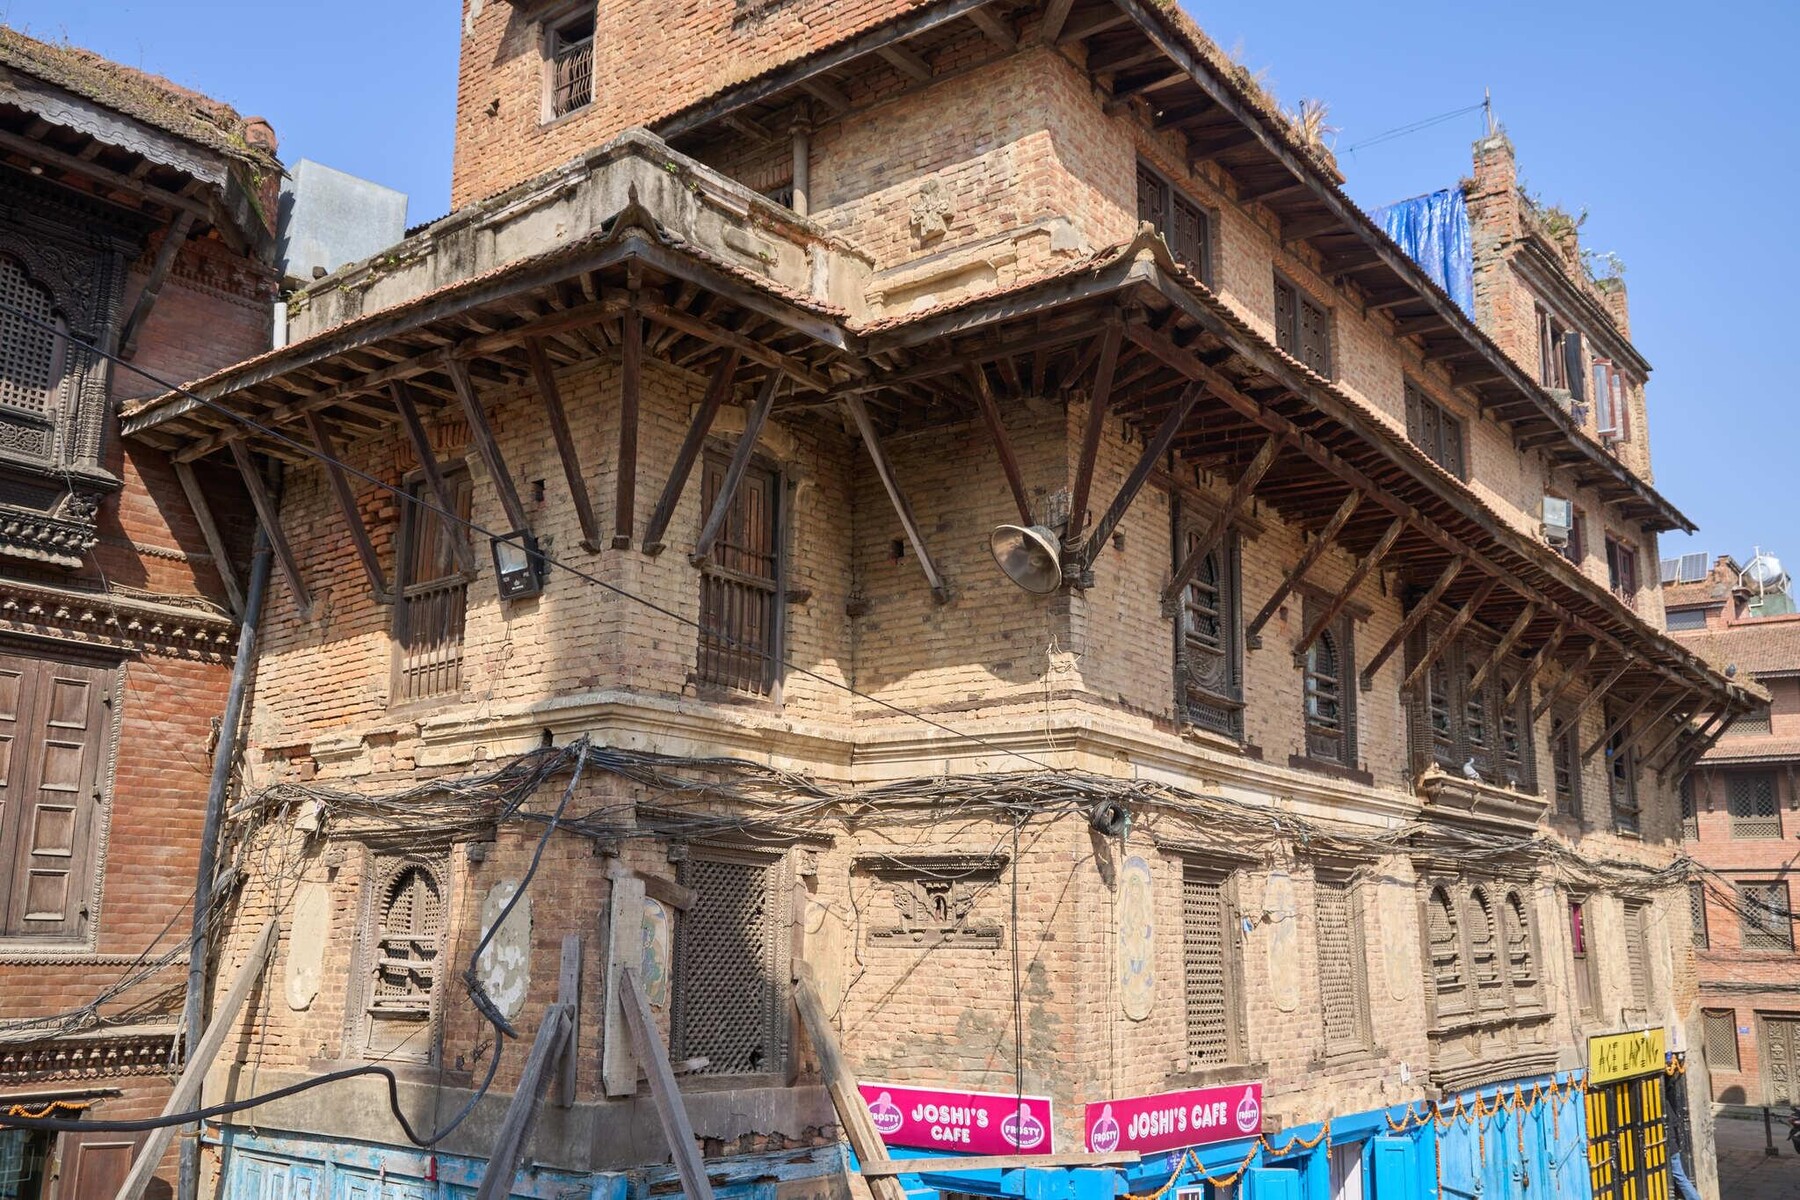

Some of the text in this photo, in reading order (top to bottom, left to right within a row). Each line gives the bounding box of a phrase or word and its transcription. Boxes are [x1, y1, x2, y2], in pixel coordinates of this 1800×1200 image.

[871, 1112, 899, 1123] ROSTY
[911, 1103, 989, 1128] JOSHI'S
[1128, 1102, 1227, 1140] JOSHI'S CAFE
[930, 1127, 971, 1144] CAFE
[1094, 1129, 1117, 1143] FROSTY
